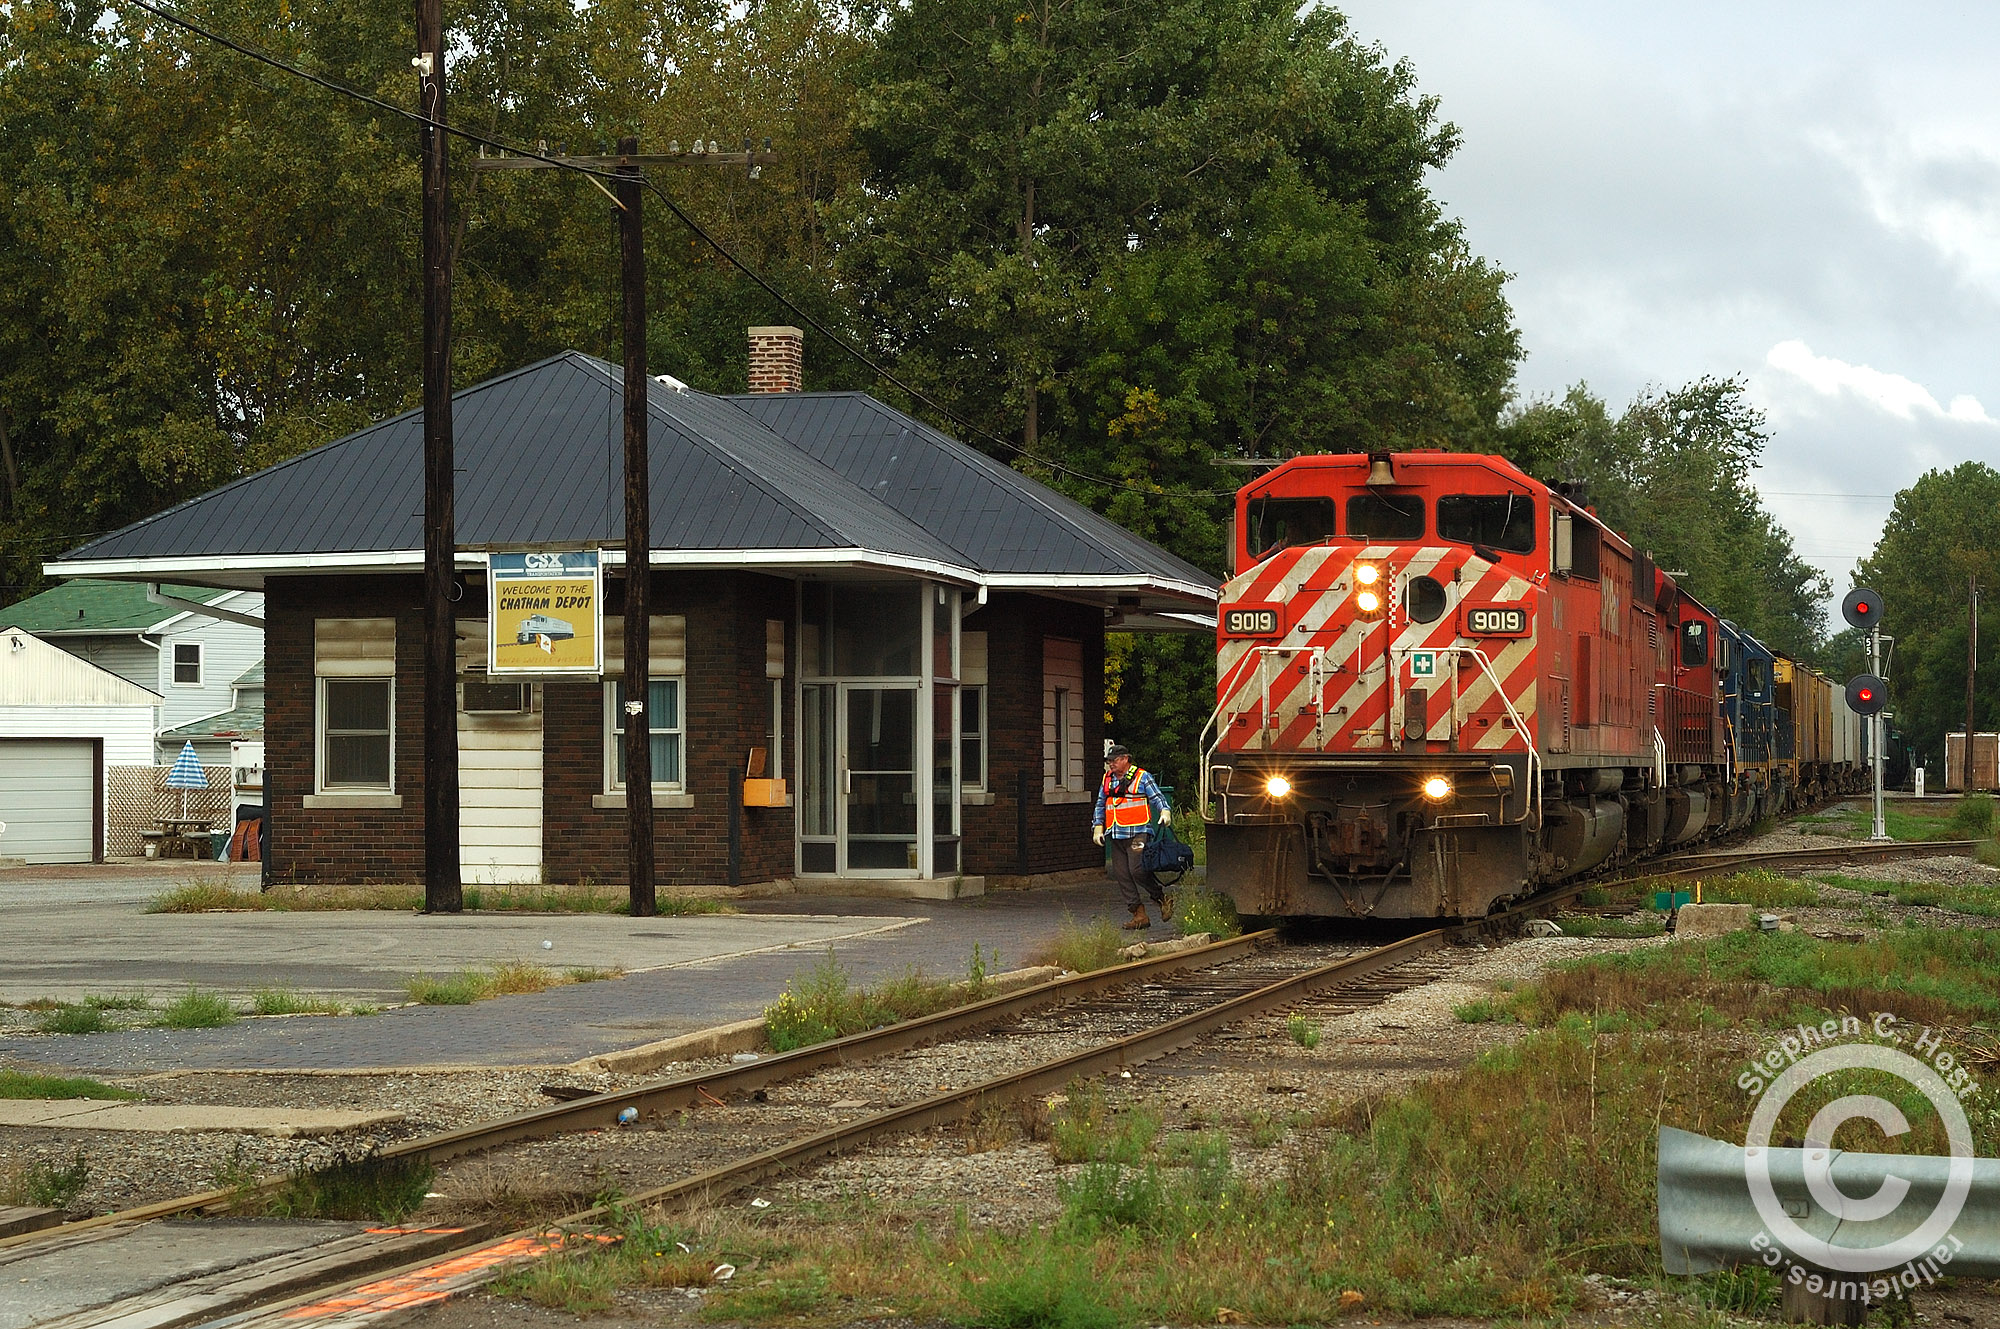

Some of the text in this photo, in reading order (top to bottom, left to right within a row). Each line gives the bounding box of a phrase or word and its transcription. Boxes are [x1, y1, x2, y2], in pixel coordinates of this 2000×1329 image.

[525, 553, 564, 568] CSX
[502, 584, 588, 595] WELCOME TO THE
[500, 596, 592, 610] CHATHAM DEPOT
[1231, 612, 1272, 631] 9019
[1474, 611, 1520, 630] 9019
